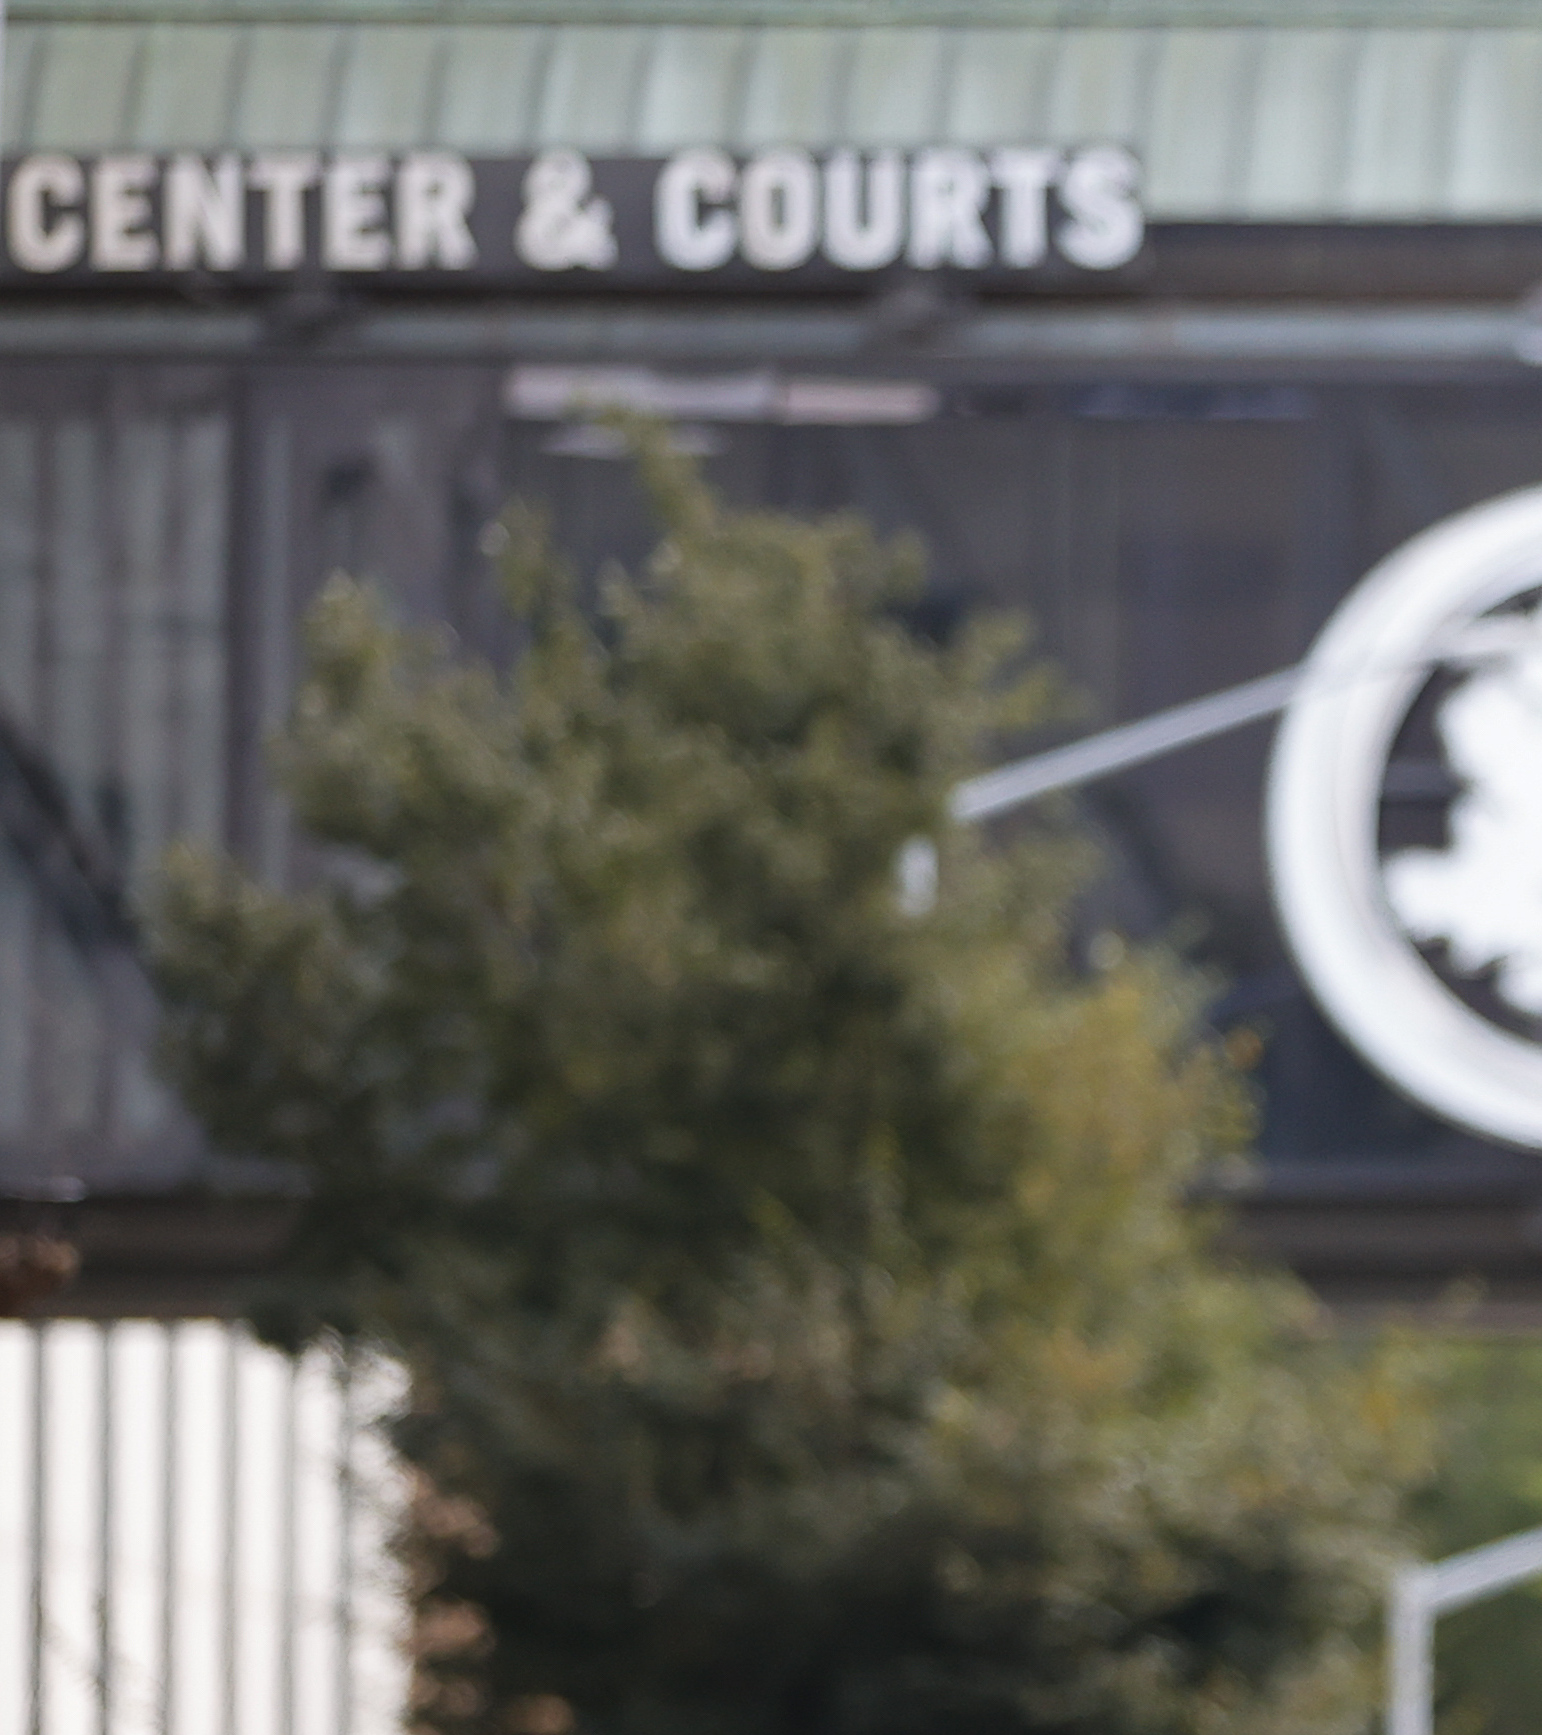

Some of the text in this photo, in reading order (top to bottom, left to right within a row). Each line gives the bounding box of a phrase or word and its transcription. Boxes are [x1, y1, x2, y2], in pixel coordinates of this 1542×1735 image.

[8, 146, 1146, 272] CENTER & COURTS
